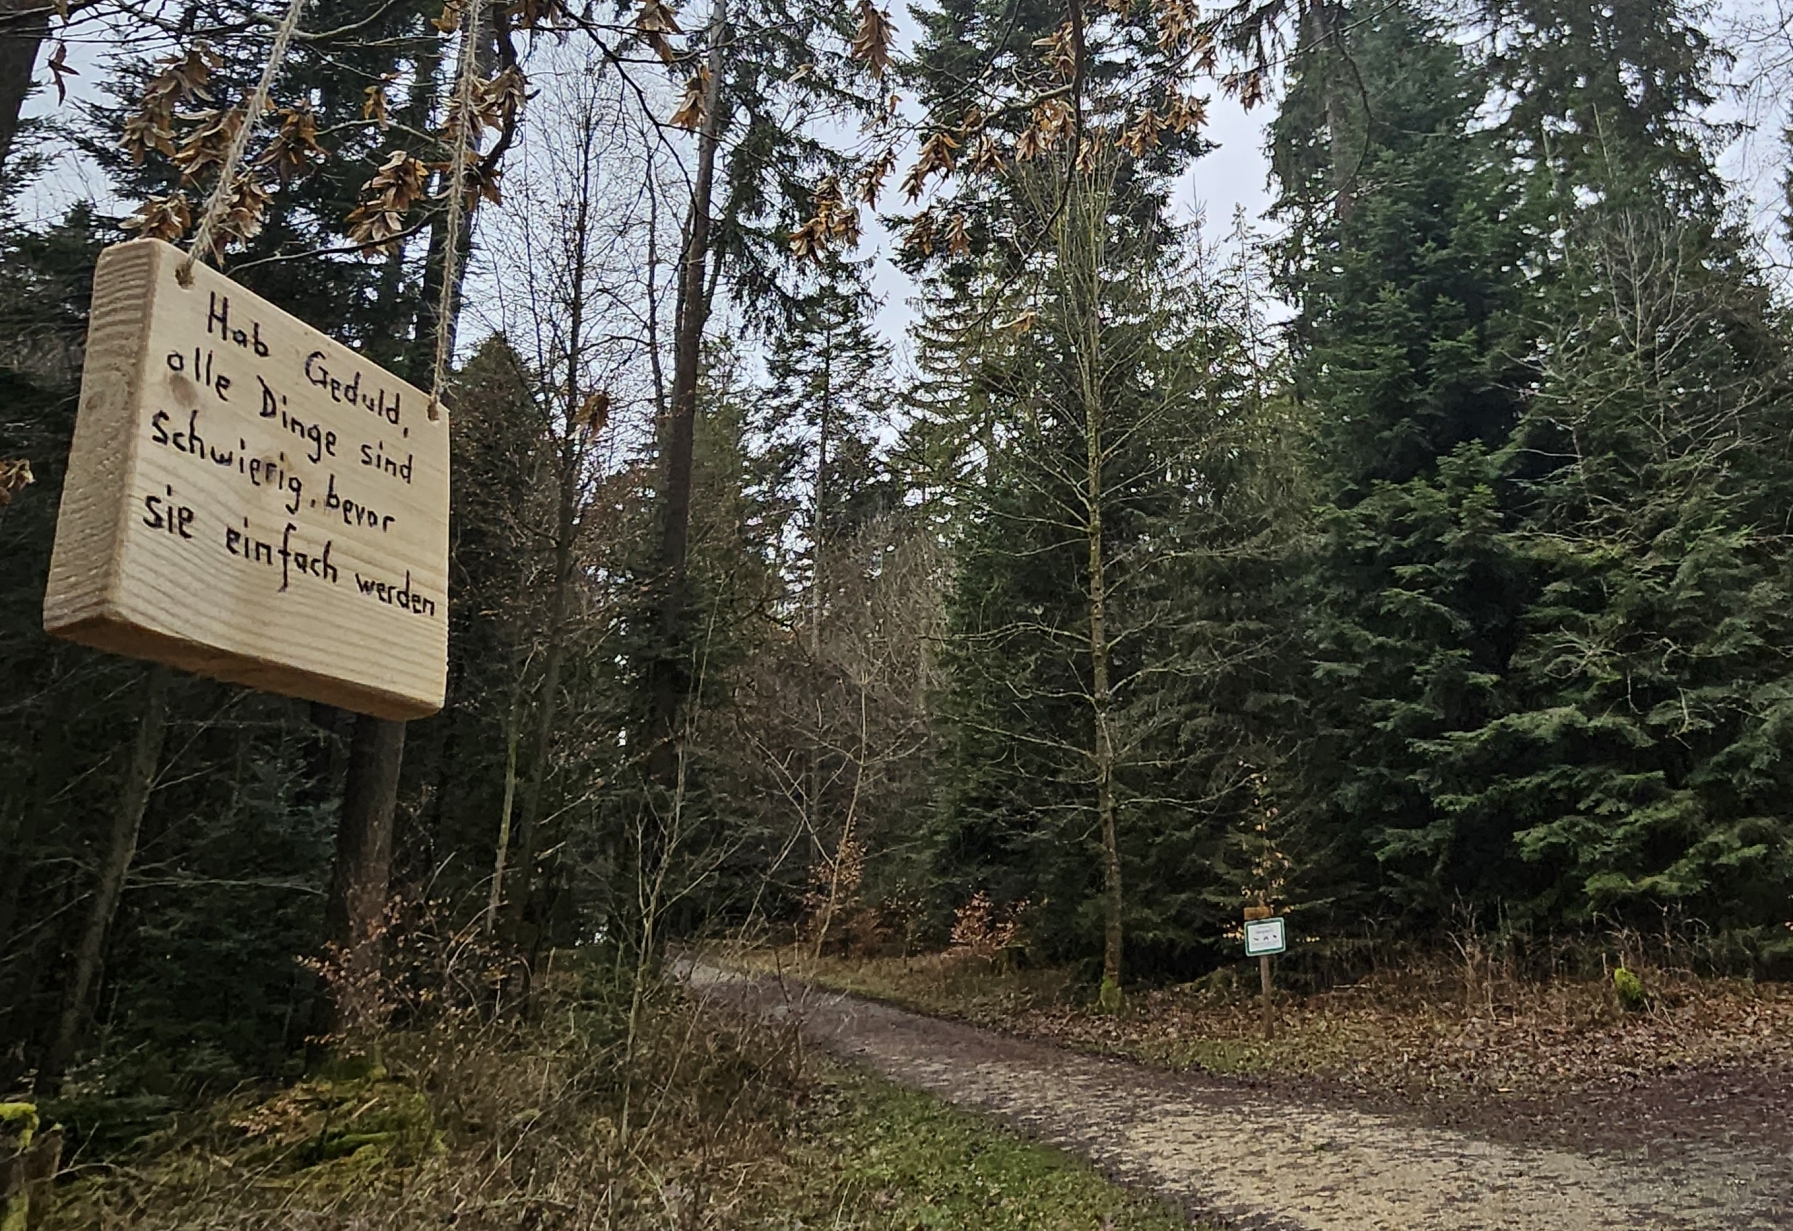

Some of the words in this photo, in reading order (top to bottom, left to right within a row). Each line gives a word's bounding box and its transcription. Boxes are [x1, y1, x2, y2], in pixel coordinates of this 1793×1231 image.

[207, 291, 269, 357] Hab
[304, 351, 409, 438] Geduld,
[256, 375, 337, 464] Dinge
[360, 440, 413, 484] sind
[326, 473, 395, 533] bevor
[225, 516, 338, 593] einfach
[355, 569, 435, 616] werden
